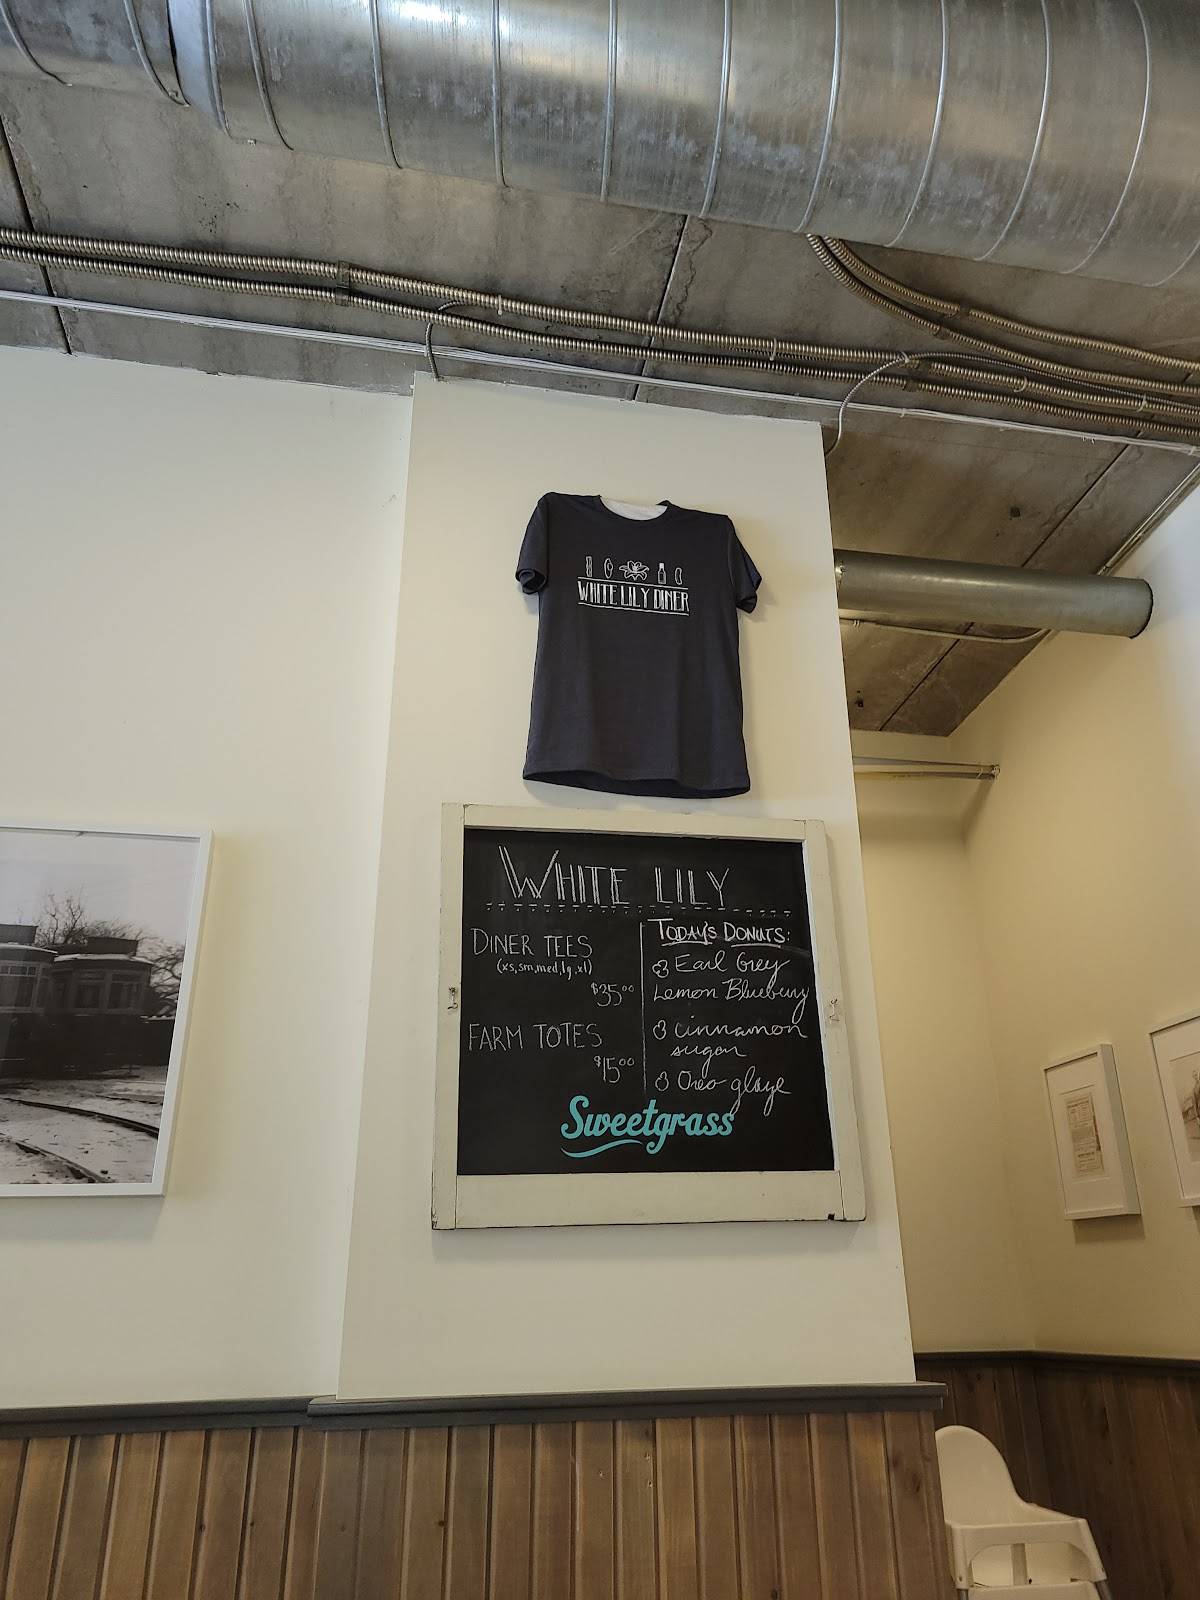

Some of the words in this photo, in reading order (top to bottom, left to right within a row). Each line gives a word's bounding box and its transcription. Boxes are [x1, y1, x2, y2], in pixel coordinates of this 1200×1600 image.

[577, 581, 618, 606] WHITE
[620, 585, 650, 608] LILY
[653, 588, 690, 612] DINER
[498, 845, 630, 905] WHITE
[654, 867, 730, 908] LILY
[471, 927, 535, 957] DINER
[543, 934, 593, 958] TEES
[675, 949, 728, 973] Earl
[736, 951, 791, 988] Grey
[653, 982, 719, 1002] Lemon
[468, 1022, 524, 1052] FARM
[533, 1021, 603, 1050] TOTES
[670, 1042, 748, 1080] sugar
[678, 1069, 728, 1092] Oreo
[560, 1095, 735, 1155] Sweetgrass
